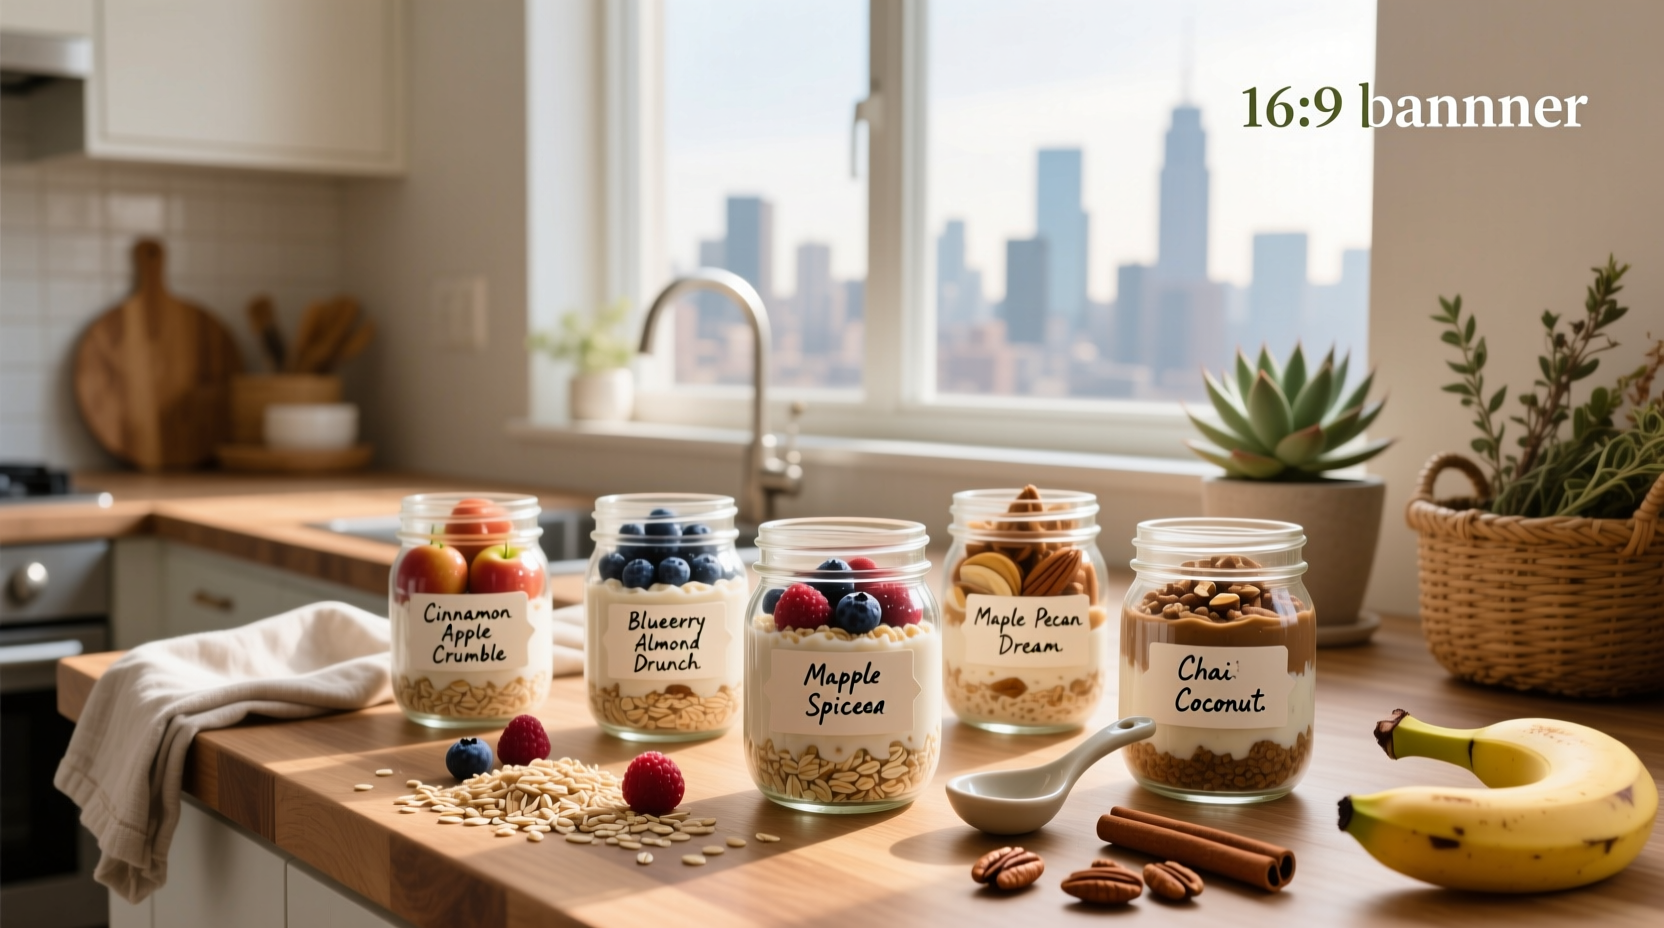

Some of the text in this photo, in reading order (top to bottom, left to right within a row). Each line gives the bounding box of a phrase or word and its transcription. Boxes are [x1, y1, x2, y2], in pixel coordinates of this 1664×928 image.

[424, 602, 512, 623] Cinnamon
[974, 606, 1083, 635] Maple Pecan
[628, 610, 706, 638] Blueerry
[441, 623, 492, 648] Apple
[634, 632, 700, 652] Almond
[999, 634, 1063, 655] Dream
[432, 643, 507, 664] Crumble
[634, 652, 701, 673] Drunch
[803, 661, 881, 695] Mapple
